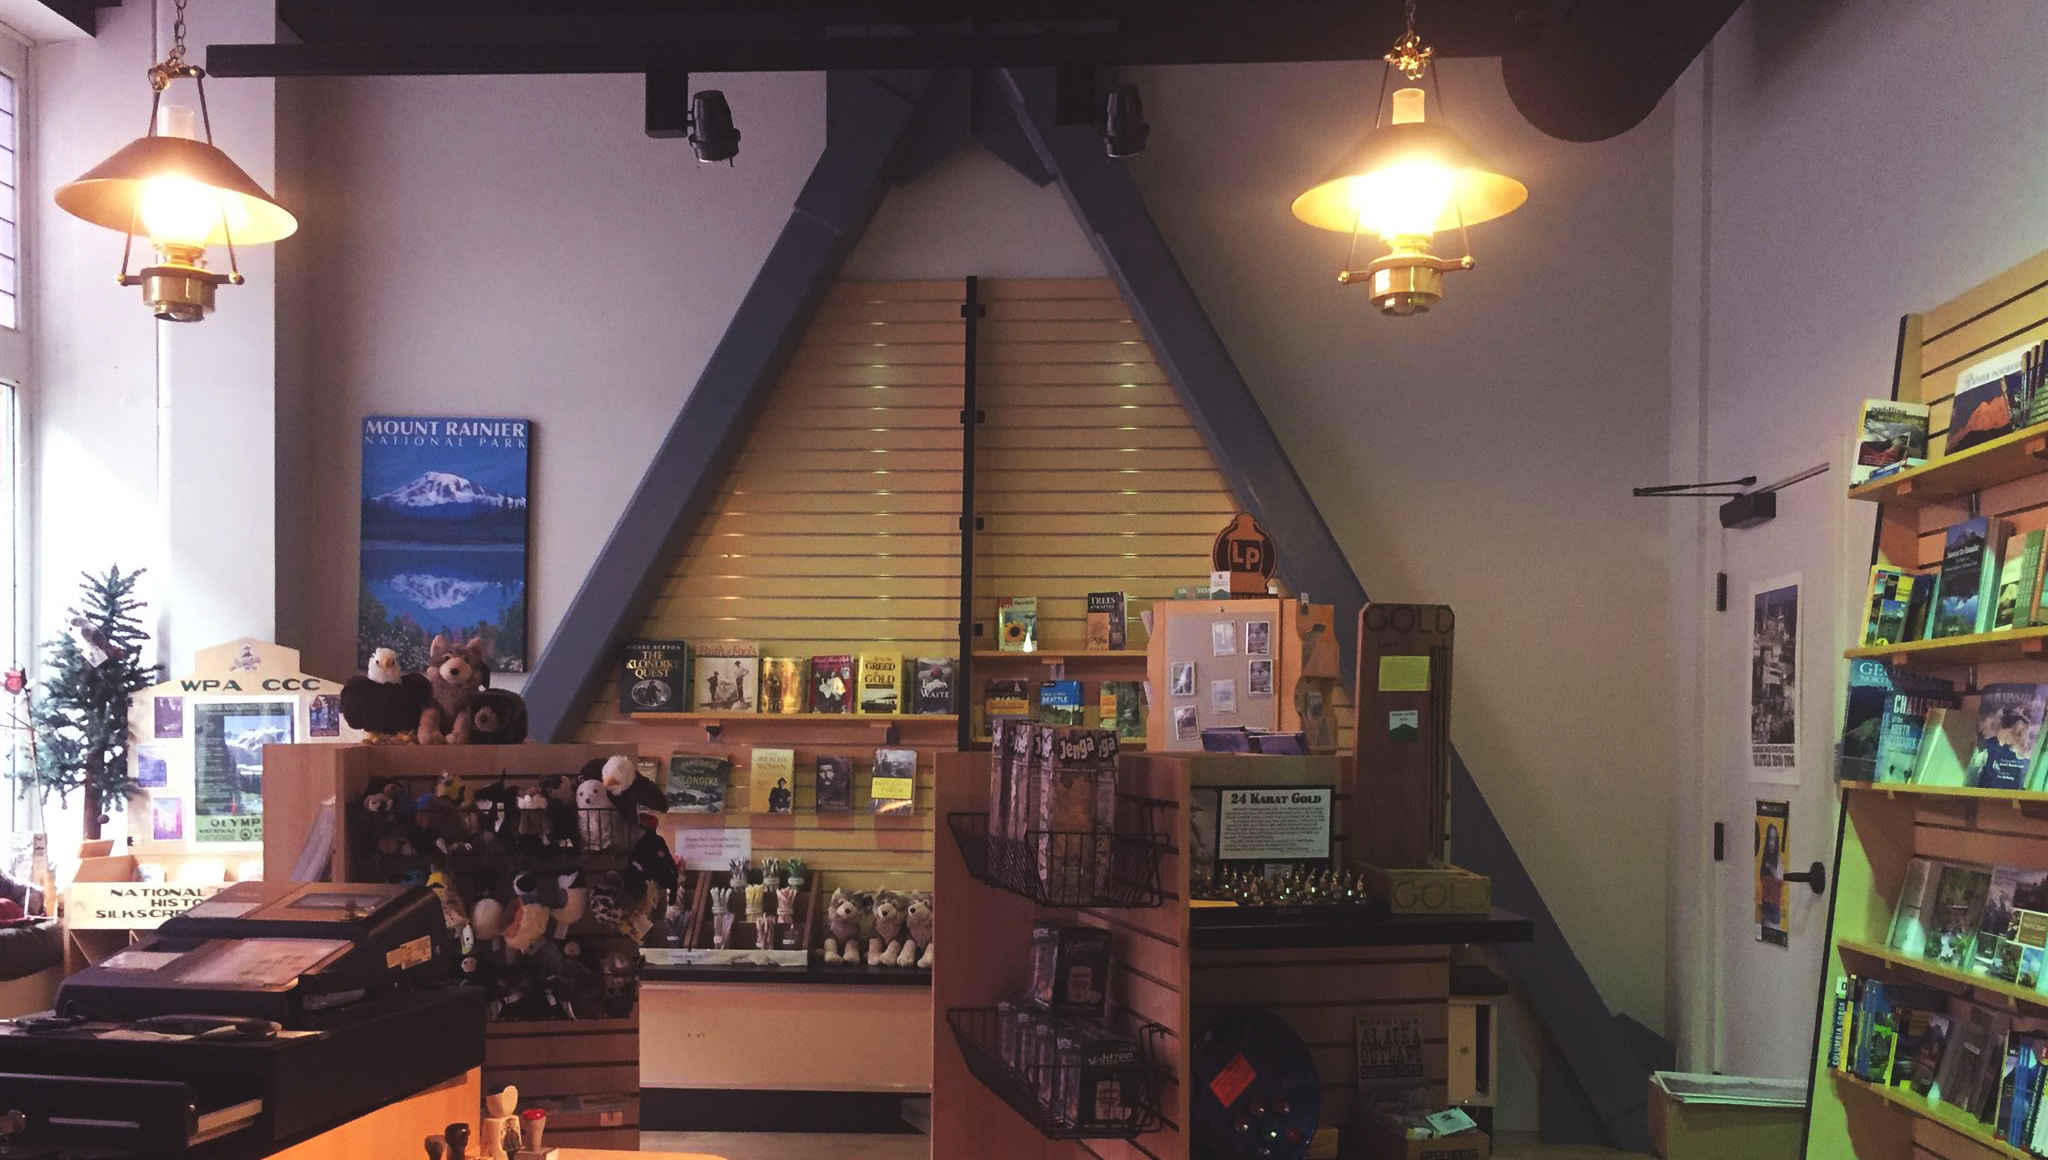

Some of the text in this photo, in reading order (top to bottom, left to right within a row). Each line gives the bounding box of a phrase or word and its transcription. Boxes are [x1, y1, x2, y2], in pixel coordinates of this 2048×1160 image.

[365, 420, 525, 438] MOUNT RAINIER
[364, 435, 526, 448] NATIONAL PARK
[1363, 603, 1455, 634] GOLD
[641, 650, 664, 660] THE
[625, 659, 681, 669] KLONDIKE
[865, 662, 896, 672] GREED
[634, 668, 671, 680] QUEST
[864, 674, 896, 684] GOLD
[181, 678, 321, 692] WPA CCC
[1059, 735, 1095, 760] Jenga
[1230, 792, 1322, 804] 24 KARAT GOLD
[110, 888, 206, 898] NATIONAL
[1394, 880, 1490, 909] GOLD
[1360, 1026, 1421, 1046] ALASKA
